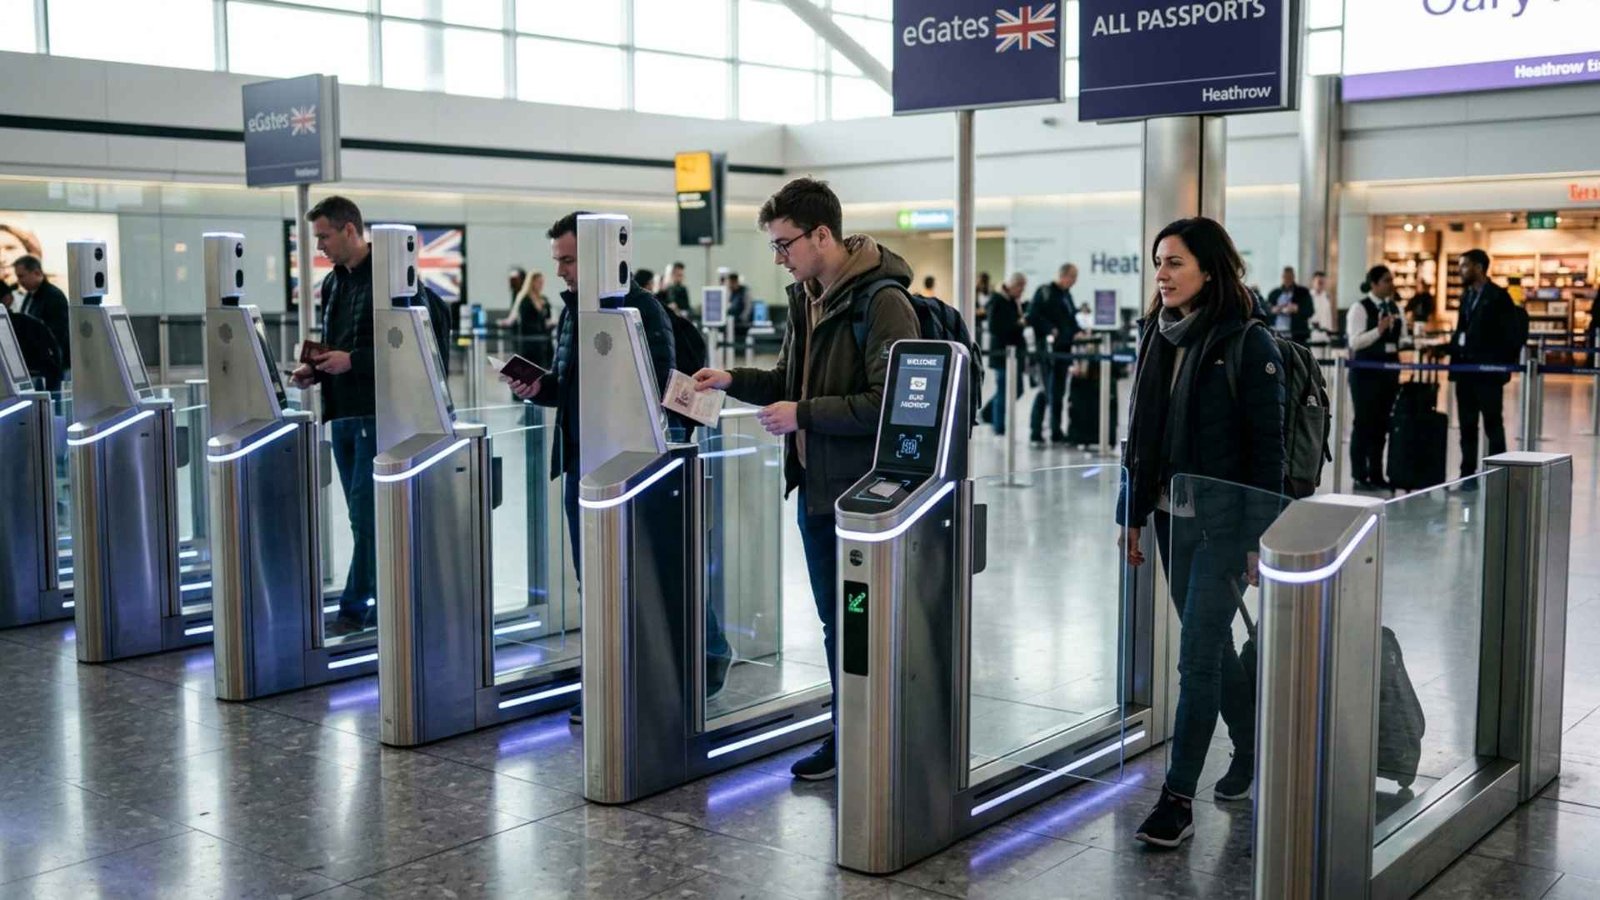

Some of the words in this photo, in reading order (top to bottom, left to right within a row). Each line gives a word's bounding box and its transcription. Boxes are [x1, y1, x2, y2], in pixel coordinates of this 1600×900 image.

[1092, 13, 1131, 37] ALL
[1137, 0, 1266, 32] PASSPORTS
[903, 15, 990, 47] eGates
[1514, 61, 1585, 79] Heathrow
[1202, 84, 1272, 102] Heathrow
[1090, 252, 1140, 274] Heat
